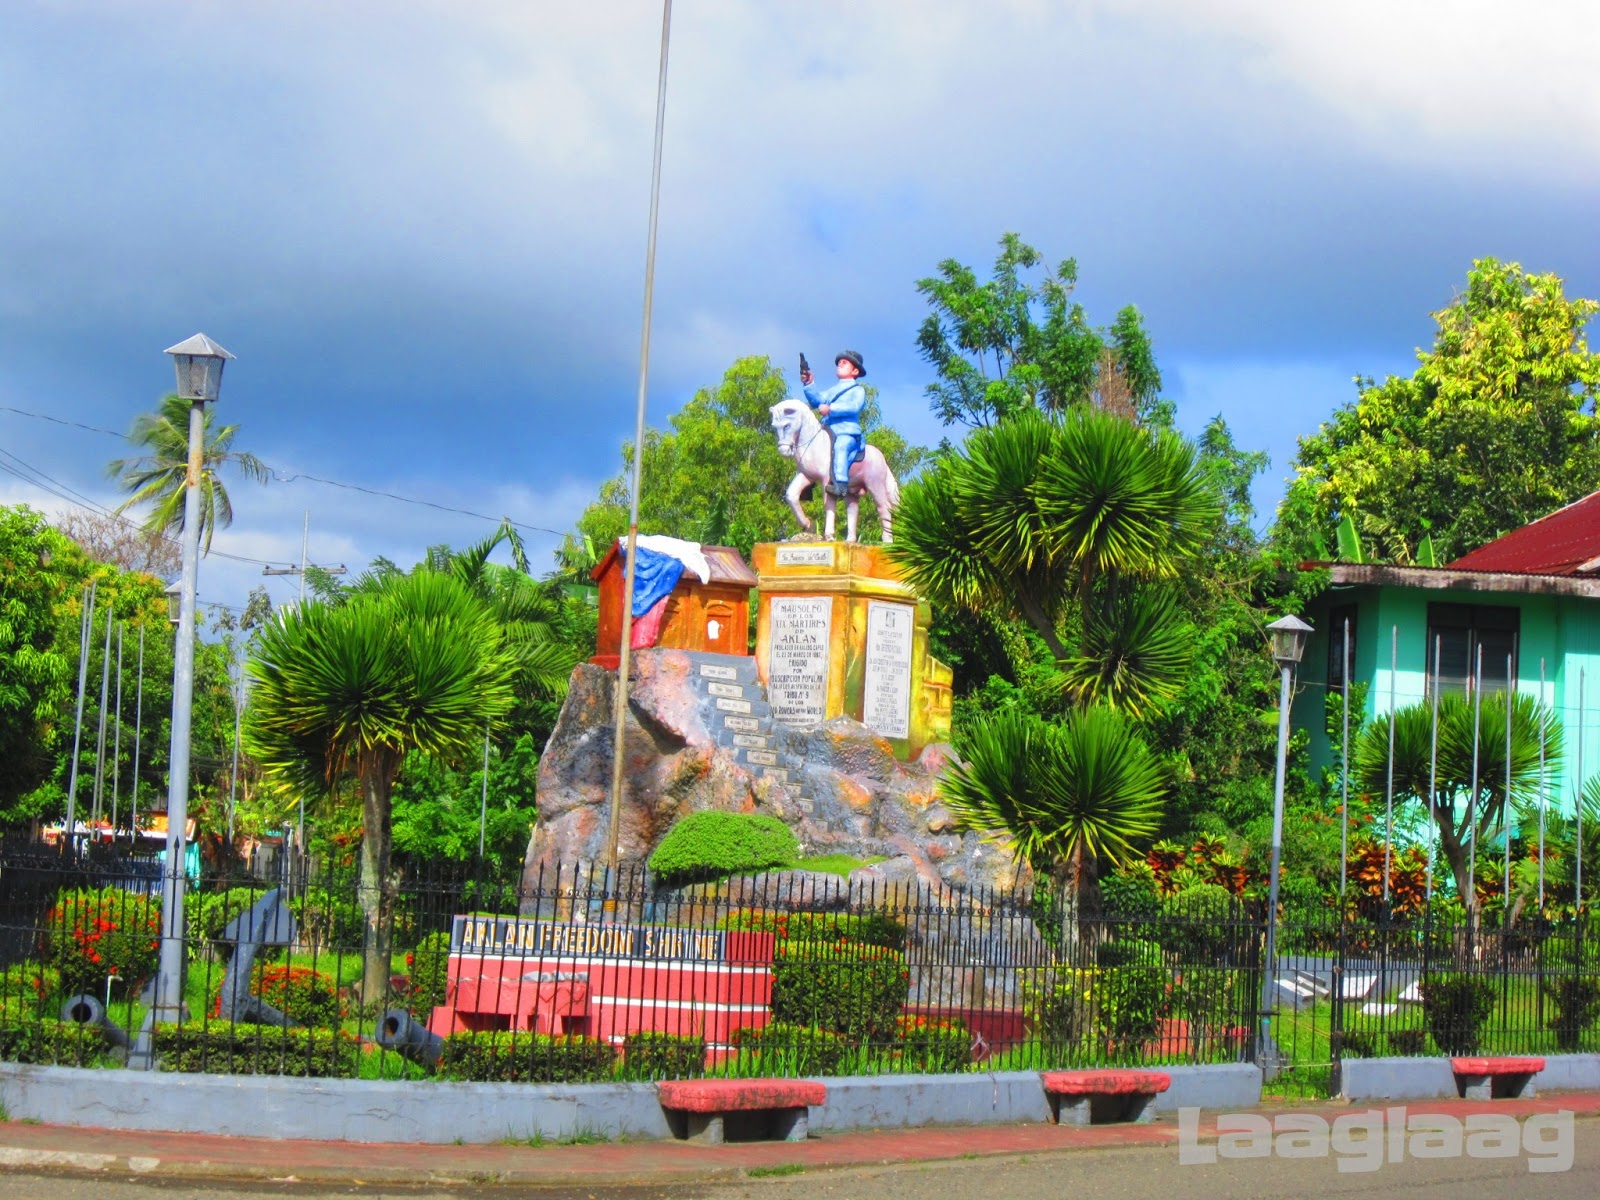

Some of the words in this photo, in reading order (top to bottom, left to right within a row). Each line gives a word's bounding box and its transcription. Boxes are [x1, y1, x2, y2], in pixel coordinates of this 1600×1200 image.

[780, 634, 816, 644] AKLAN
[463, 921, 535, 950] AKLAN
[540, 924, 634, 955] FREEDOM
[644, 930, 718, 960] SHRINE
